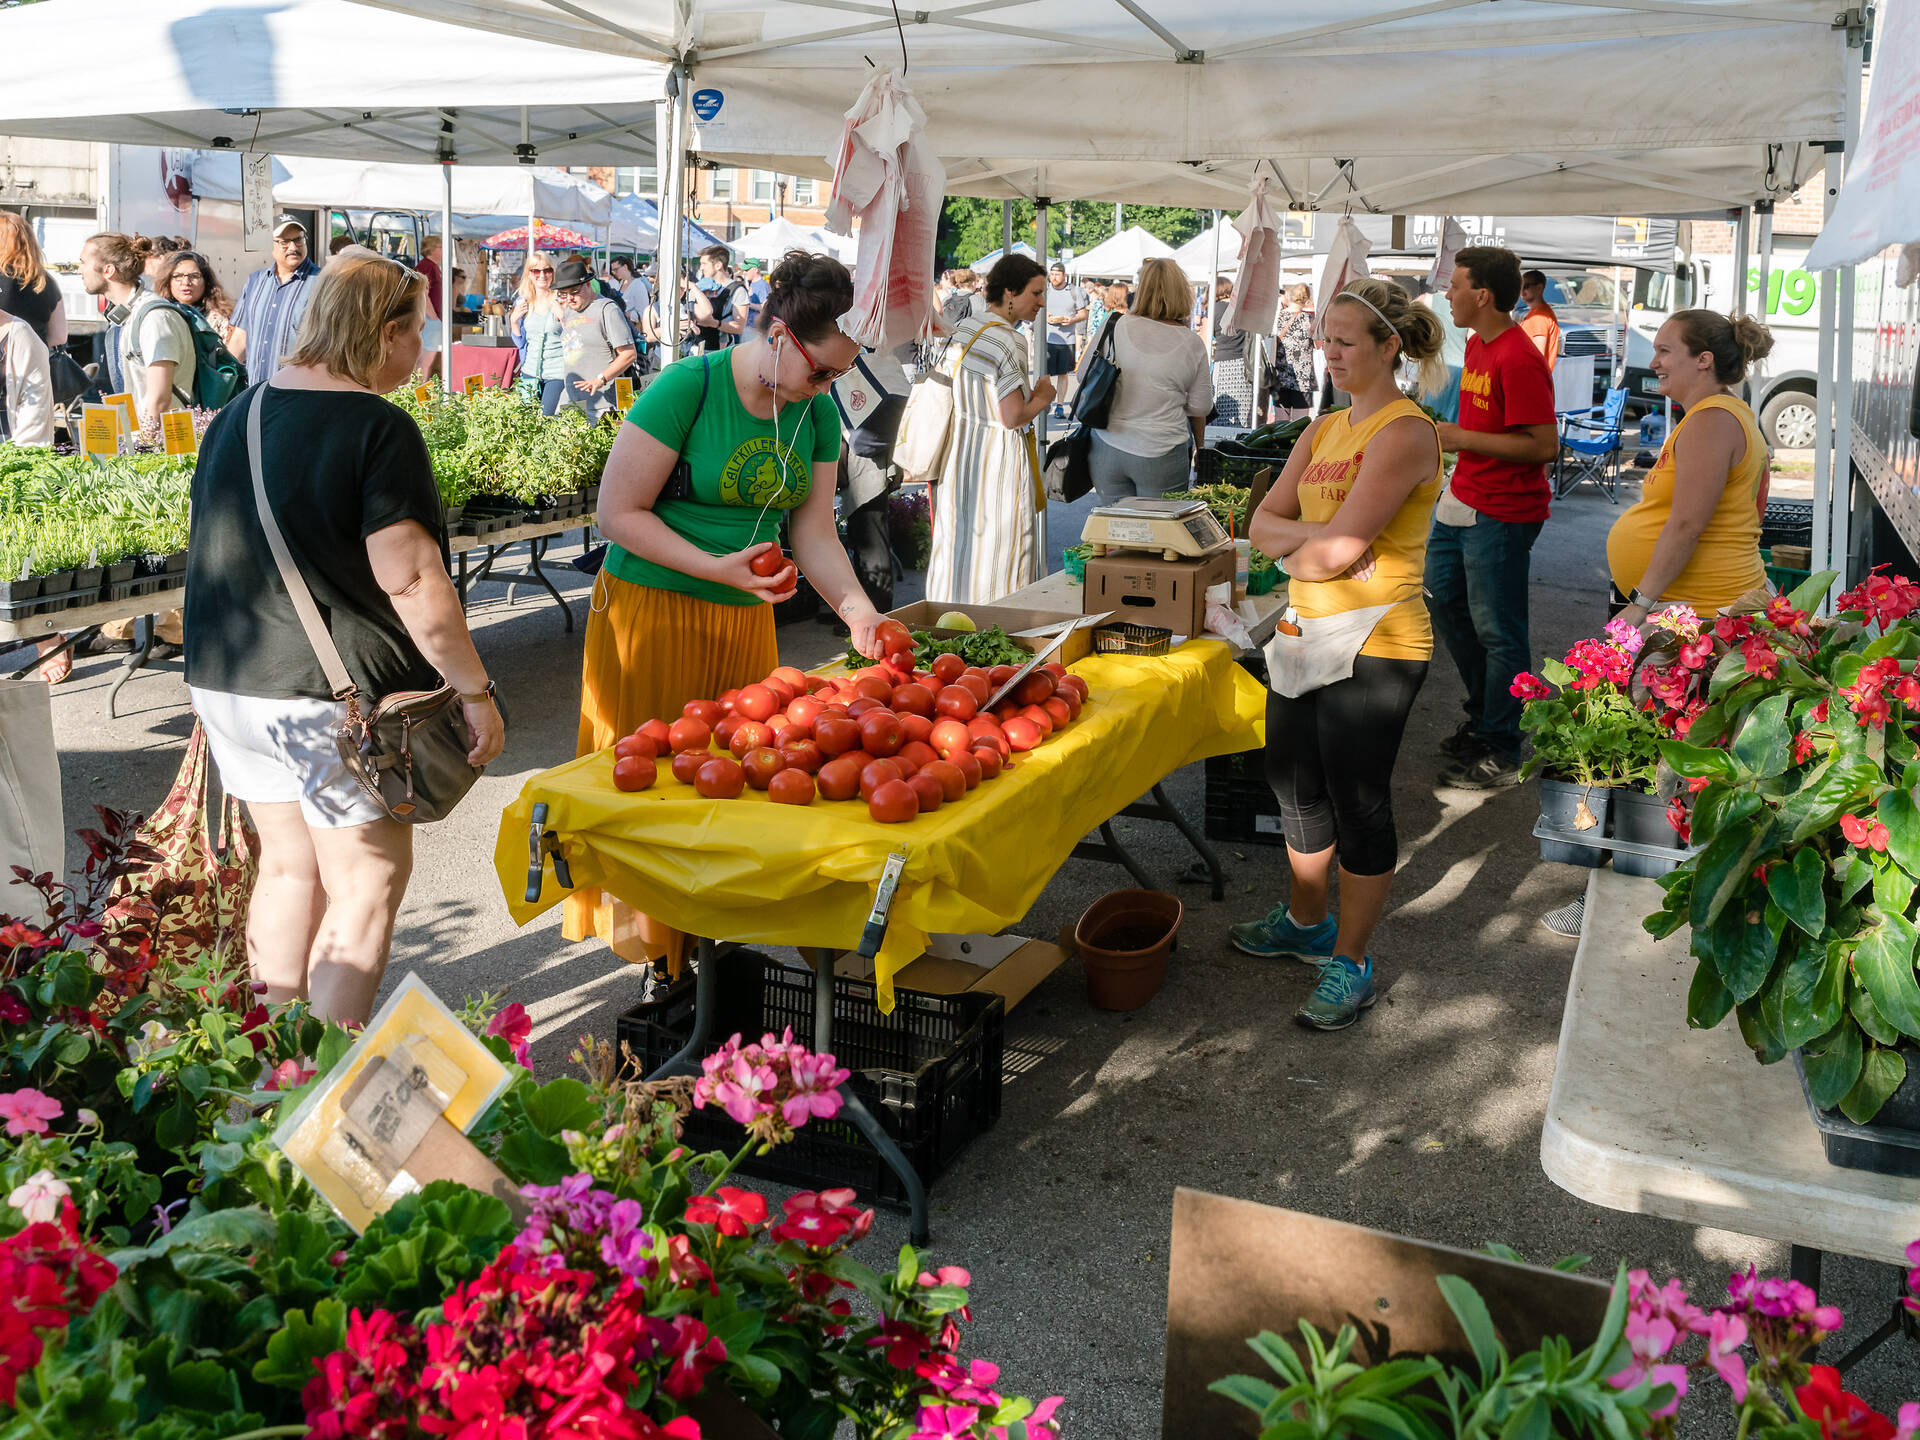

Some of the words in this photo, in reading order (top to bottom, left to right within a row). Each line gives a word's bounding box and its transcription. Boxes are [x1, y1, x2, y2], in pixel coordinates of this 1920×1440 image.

[1413, 215, 1506, 236] hal.
[1474, 235, 1506, 247] Clinic
[723, 439, 776, 489] CALFKILLER
[1320, 485, 1347, 502] FAR
